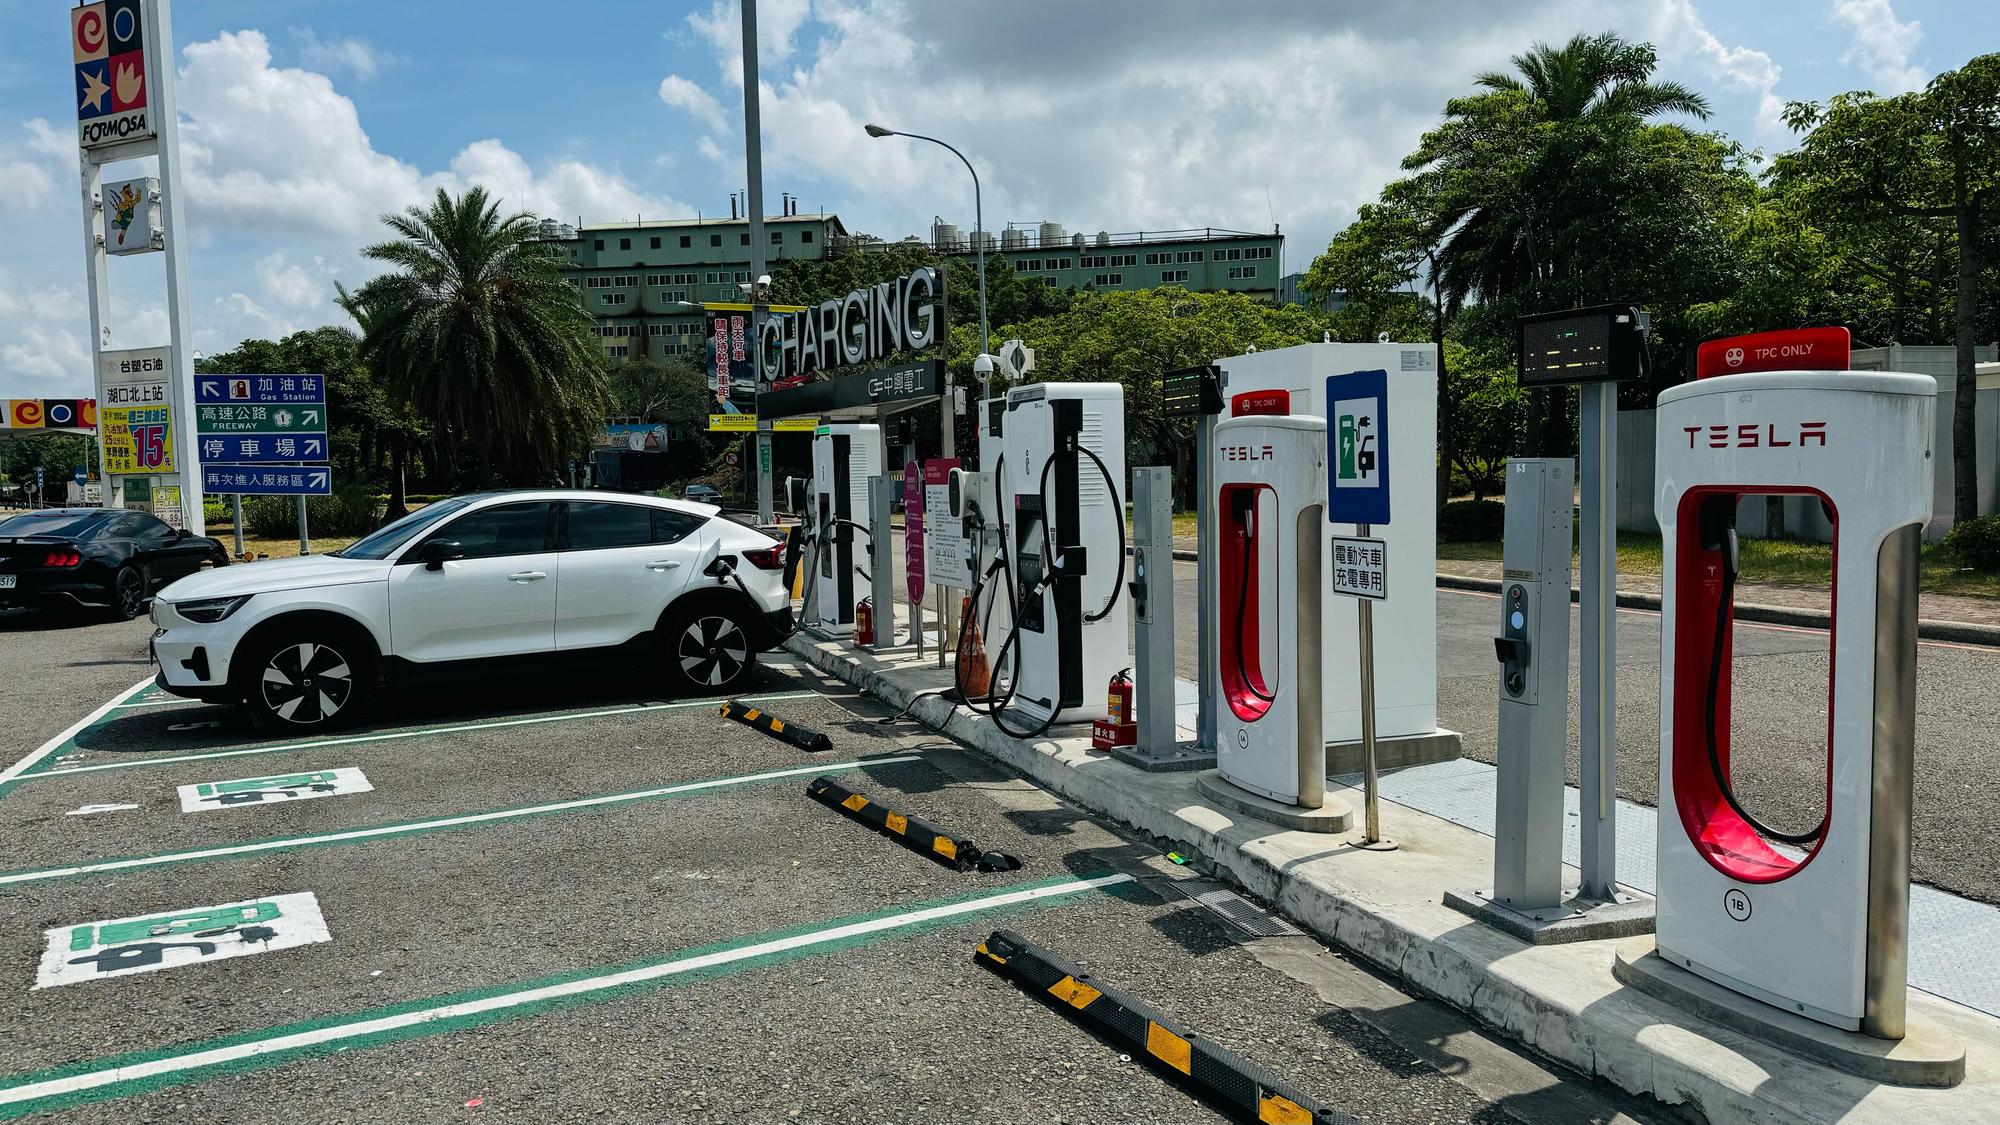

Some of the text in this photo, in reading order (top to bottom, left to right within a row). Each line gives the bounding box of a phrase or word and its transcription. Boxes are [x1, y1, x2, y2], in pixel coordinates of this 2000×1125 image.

[83, 114, 146, 142] FORMOSA
[731, 316, 745, 361] 雨天行車
[1755, 343, 1814, 360] TPC ONLY
[120, 358, 163, 373] 台塑石油
[258, 378, 316, 391] 加油站
[884, 368, 925, 396] 中興電工
[107, 385, 163, 403] 湖口北上站
[201, 406, 267, 420] 高速公路
[212, 422, 258, 430] FREEWAY
[1683, 422, 1827, 449] TESLA
[133, 425, 164, 469] 15
[203, 438, 296, 458] 停車場
[1220, 445, 1273, 461] TESLA
[207, 473, 304, 486] 再次進入服務區
[1335, 545, 1382, 567] 電動汽車
[1335, 568, 1382, 591] 充電專用
[1732, 899, 1744, 911] 1B
